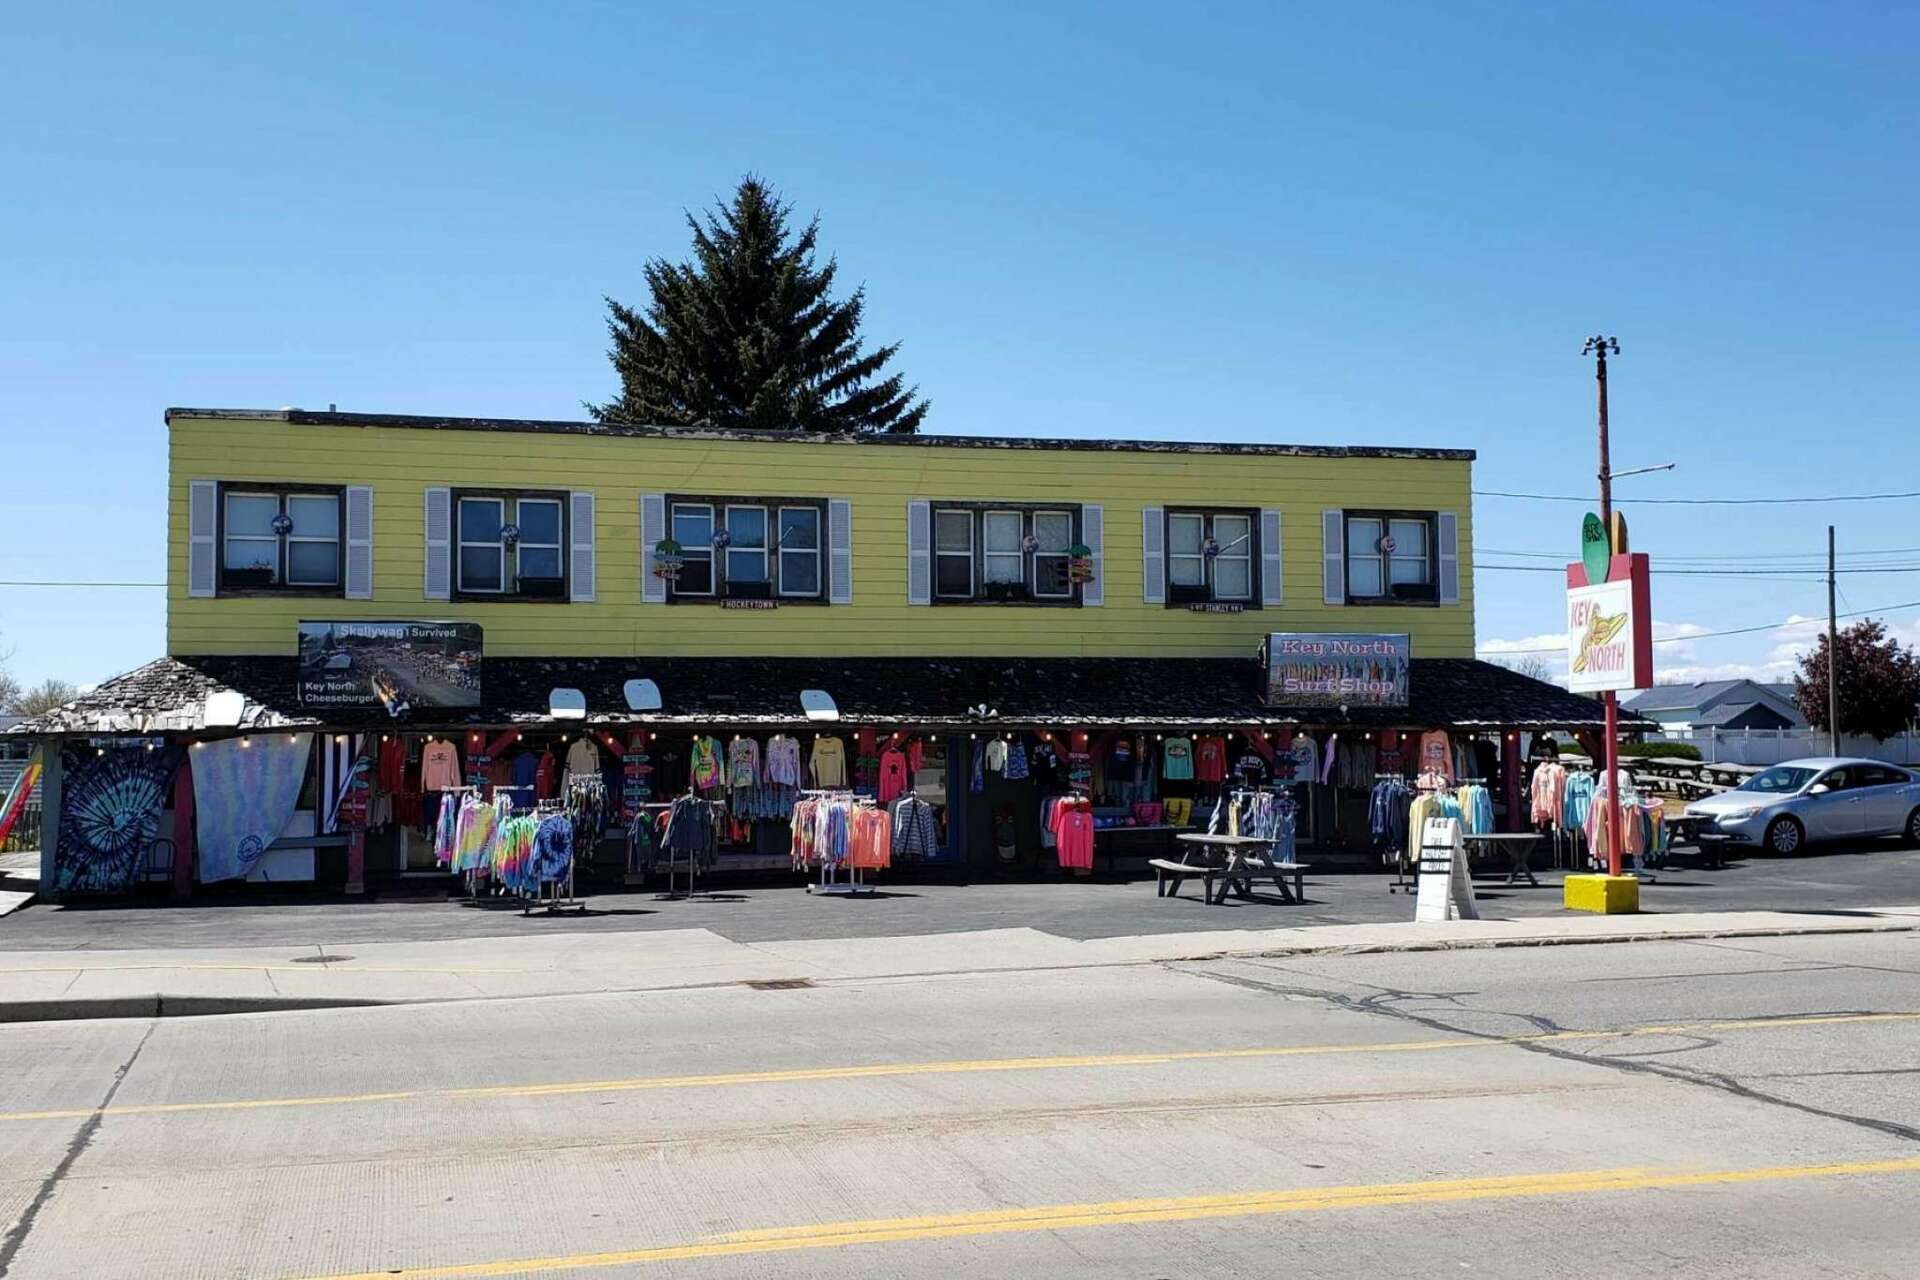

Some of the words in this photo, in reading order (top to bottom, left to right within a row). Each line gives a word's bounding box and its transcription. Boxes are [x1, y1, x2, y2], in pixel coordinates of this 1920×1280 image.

[727, 600, 774, 609] HOCKEYTOWN
[1571, 601, 1592, 628] KEY
[341, 624, 404, 639] Skallywag
[412, 627, 457, 638] Survived
[1282, 640, 1325, 656] Key
[1332, 640, 1396, 655] North
[1589, 643, 1625, 672] NORTH
[305, 682, 325, 693] Key
[327, 681, 356, 691] North
[1284, 677, 1336, 694] Surf
[1340, 677, 1394, 695] Shop
[305, 693, 374, 704] Cheeseburger
